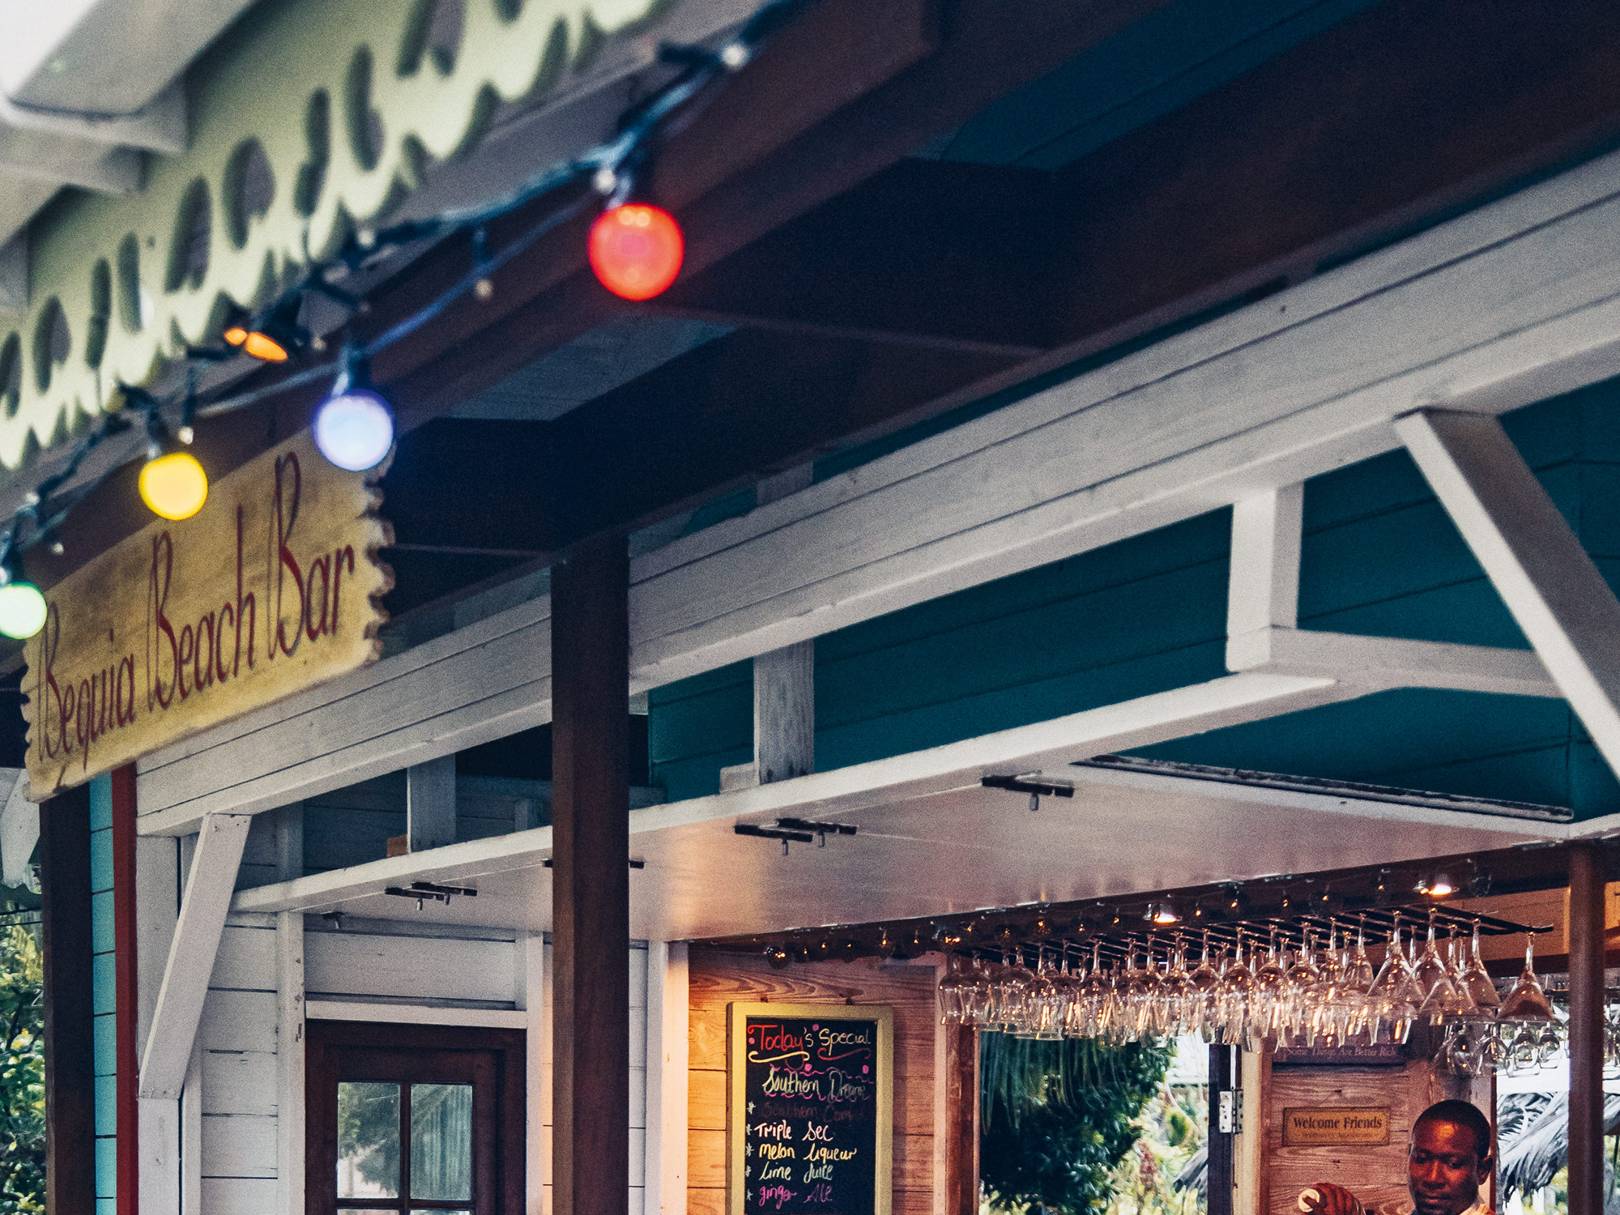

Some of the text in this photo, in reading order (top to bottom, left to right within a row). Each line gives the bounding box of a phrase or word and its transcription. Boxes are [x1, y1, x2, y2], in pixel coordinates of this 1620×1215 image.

[38, 450, 356, 772] Bequia Beach Bar
[747, 1024, 814, 1060] Today's
[762, 1067, 826, 1100] Southern
[1293, 1116, 1383, 1129] Welcome Friends
